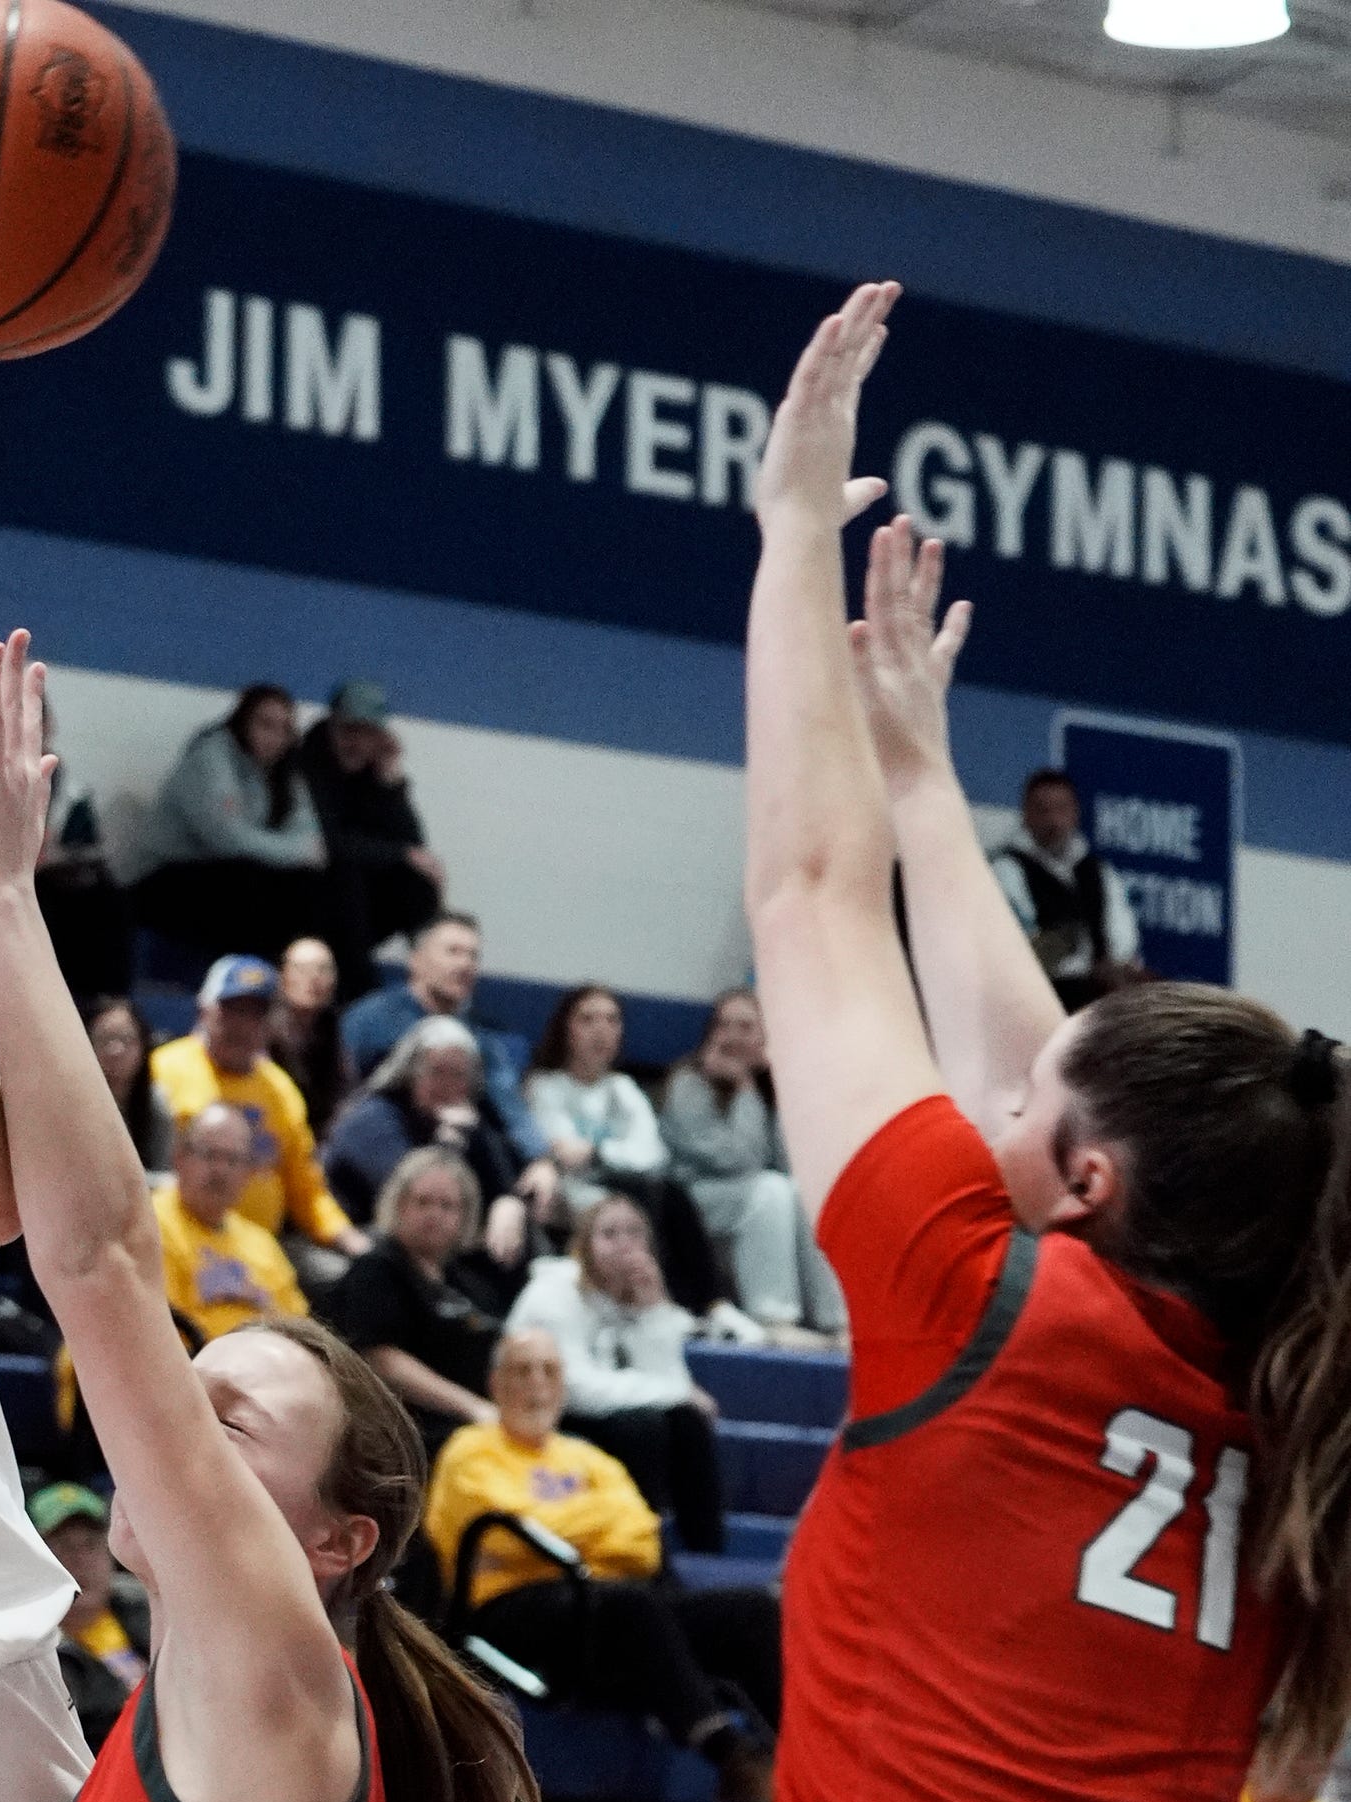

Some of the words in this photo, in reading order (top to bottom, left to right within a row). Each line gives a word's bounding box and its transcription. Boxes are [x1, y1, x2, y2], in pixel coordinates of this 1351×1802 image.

[164, 288, 382, 443] JIM
[445, 332, 771, 514] MYER
[892, 422, 1351, 618] GYMNAS
[1095, 797, 1202, 863] HOME
[1075, 1405, 1251, 1653] 21
